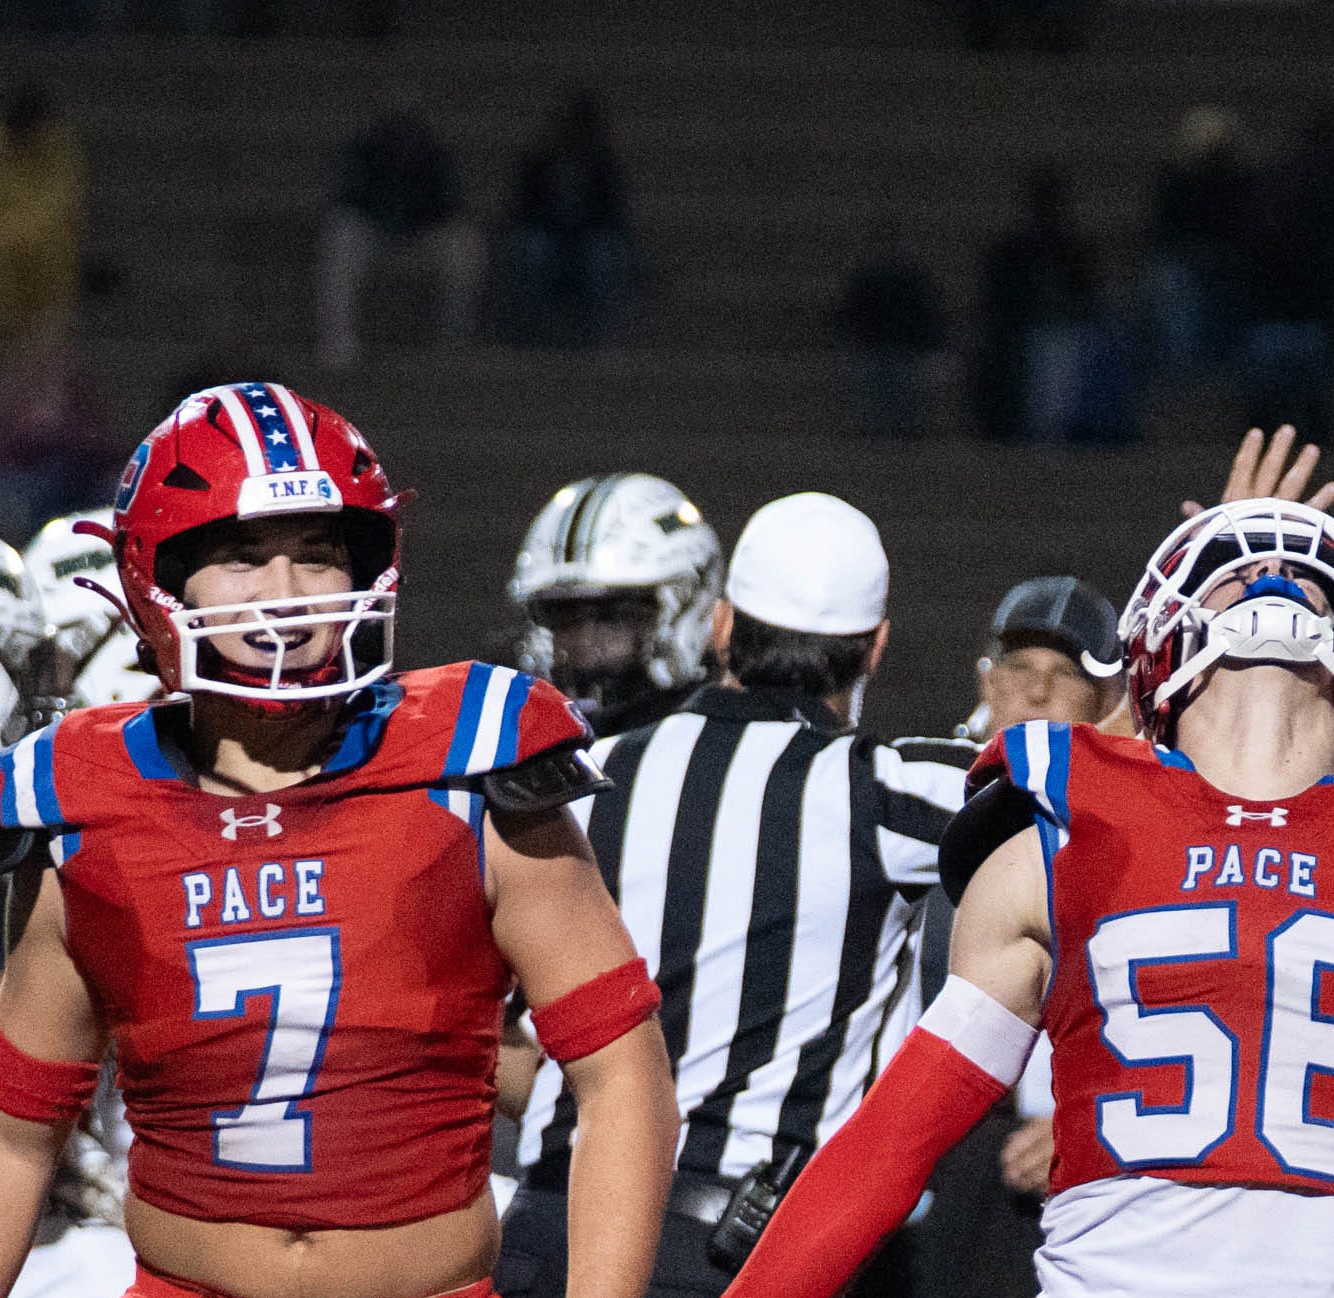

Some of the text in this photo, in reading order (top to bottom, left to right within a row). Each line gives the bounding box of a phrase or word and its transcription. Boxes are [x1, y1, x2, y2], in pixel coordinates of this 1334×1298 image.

[269, 480, 314, 498] T.N.F.
[181, 859, 325, 929] PACE
[1181, 845, 1318, 898] PACE
[185, 925, 342, 1174] 7
